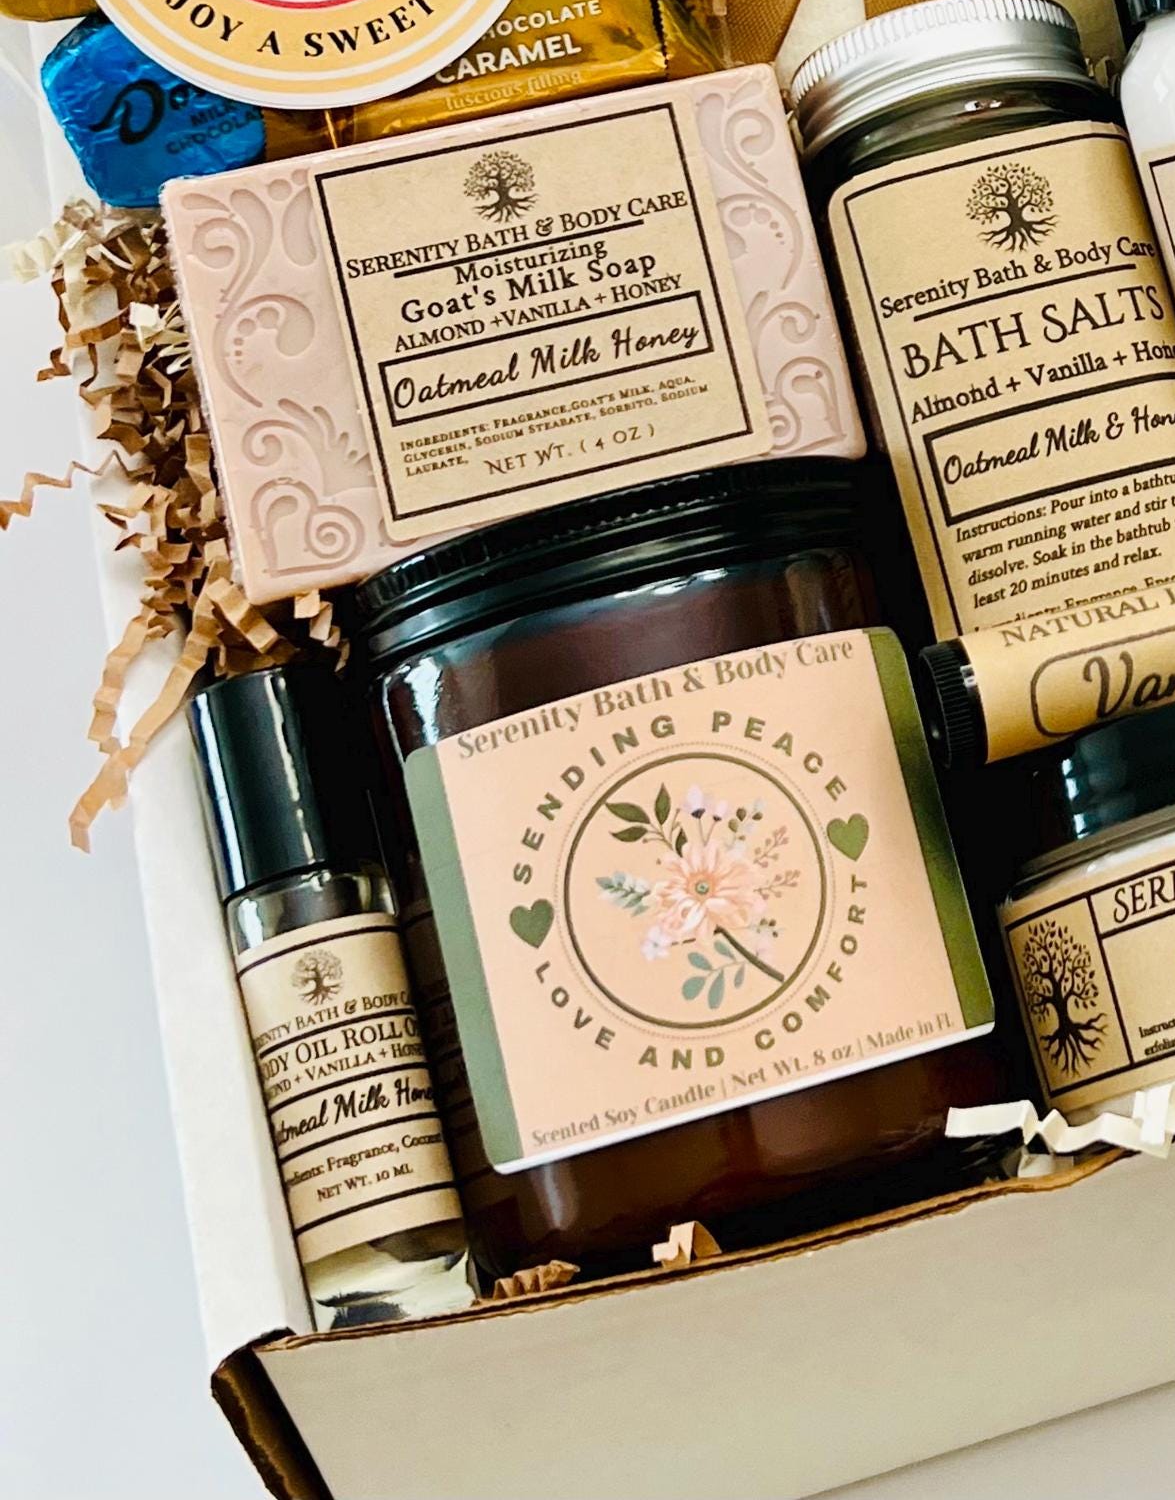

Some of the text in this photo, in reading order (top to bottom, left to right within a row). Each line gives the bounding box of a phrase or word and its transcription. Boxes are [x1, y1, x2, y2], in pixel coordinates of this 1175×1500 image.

[258, 34, 280, 55] A
[481, 0, 602, 40] OCOLATE
[445, 70, 583, 110] luscious filling
[346, 191, 689, 278] SERENITY BATH & BODY CARE
[455, 240, 608, 285] Moisturizing
[400, 254, 656, 323] Goat's Milk Soap
[880, 236, 1156, 319] Serenity Bath & Body Care
[395, 273, 683, 353] ALMOND HONEY
[901, 285, 1165, 379] BATH SALTS
[393, 323, 699, 408] Oatmeal Milk Honey
[910, 353, 1108, 424] Almond Vanilla
[595, 437, 605, 450] 4
[944, 432, 1039, 485] Oatmeal
[1045, 417, 1100, 456] Milk
[956, 505, 1047, 543] Instructions:
[1050, 495, 1086, 514] Pour
[1090, 488, 1118, 504] into
[962, 497, 1167, 564] warm running water and stir
[968, 558, 1029, 586] dissolve.
[1033, 544, 1068, 565] Soak
[1071, 537, 1086, 555] in
[1090, 532, 1113, 550] the
[1116, 516, 1171, 543] bathtub
[973, 544, 1162, 609] least 20 minutes and relax.
[999, 597, 1159, 648] NATURAL
[458, 638, 853, 760] Serenity Bath Body Care
[513, 710, 848, 886] SENDING PEACE
[535, 877, 868, 1070] LOVE AND COMFORT
[295, 1021, 402, 1063] OIL ROLL
[296, 1007, 339, 1030] BATH
[305, 1053, 376, 1081] VANILLA
[532, 1115, 601, 1148] Scented
[604, 1107, 639, 1129] Soy
[644, 1083, 716, 1113] Candle
[731, 1069, 767, 1090] Net
[866, 1028, 915, 1051] Made
[335, 1083, 390, 1124] Milk
